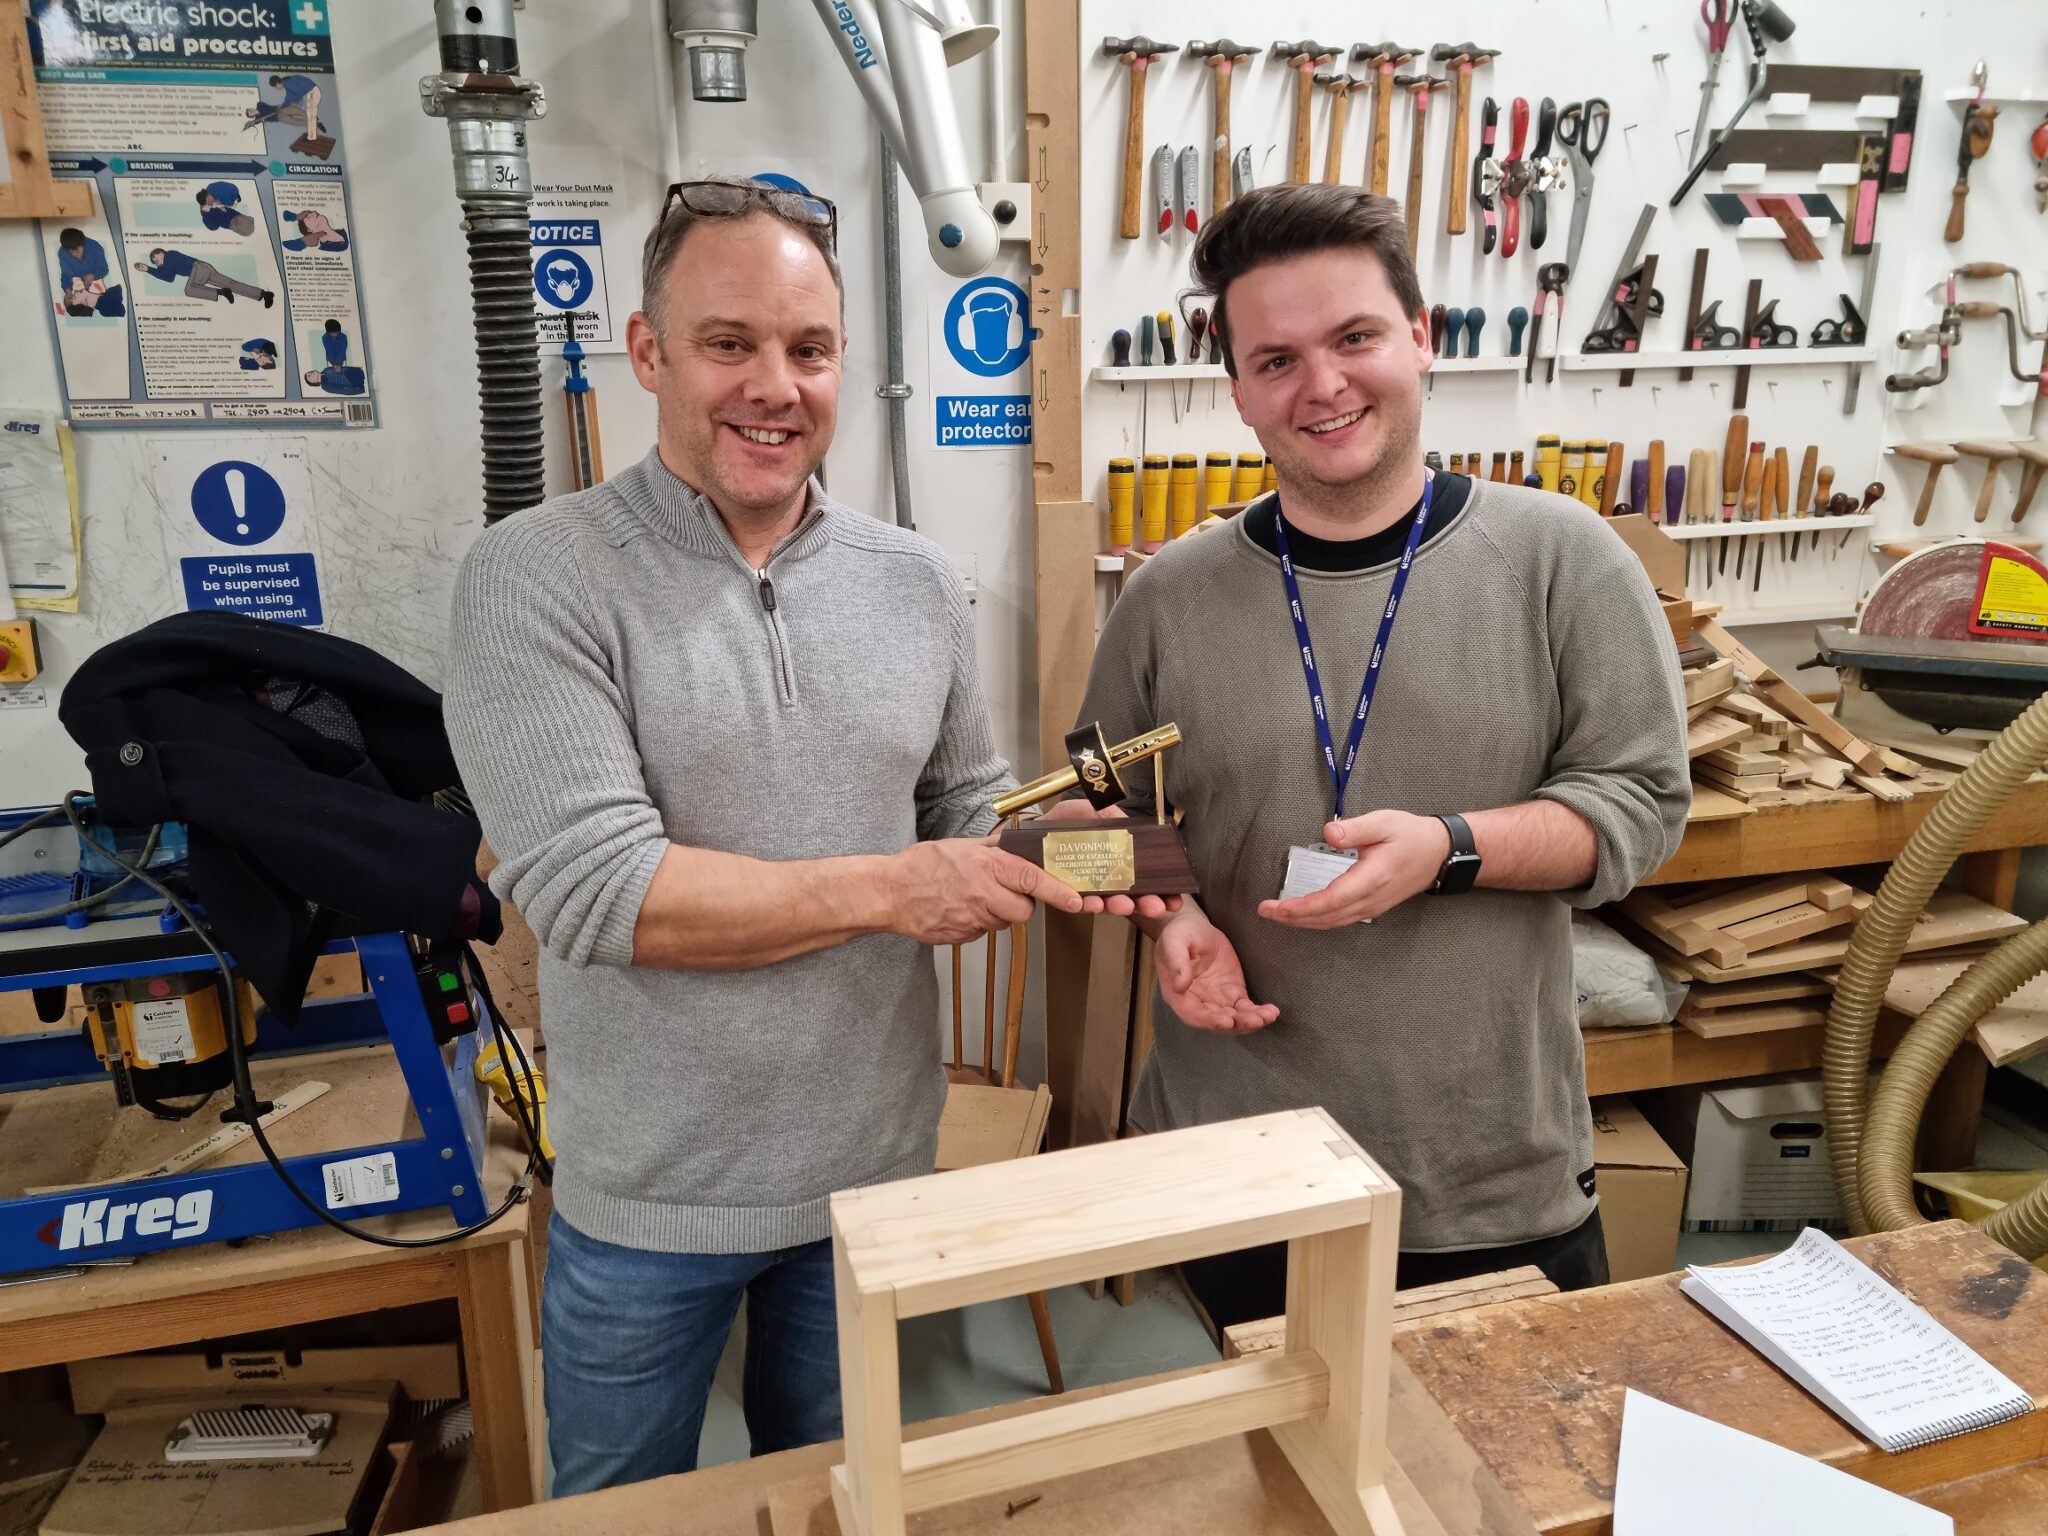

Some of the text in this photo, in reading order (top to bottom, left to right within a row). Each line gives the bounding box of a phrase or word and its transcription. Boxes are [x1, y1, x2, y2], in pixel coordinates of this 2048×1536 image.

[80, 0, 276, 29] Electric shock:
[81, 30, 318, 57] first aid procedures
[130, 162, 174, 171] BREATHING
[289, 165, 339, 174] CIRCULATION
[495, 165, 519, 188] 34
[565, 200, 587, 208] taking
[590, 200, 611, 208] place.
[574, 312, 600, 321] ask
[540, 323, 560, 331] Must
[557, 332, 568, 340] thi
[948, 401, 1000, 419] Wear
[941, 424, 1031, 444] protector
[208, 562, 290, 577] Pupils must
[203, 576, 300, 592] be supervised
[214, 592, 294, 607] when using
[240, 607, 307, 621] quipment
[58, 1189, 214, 1251] Kreg
